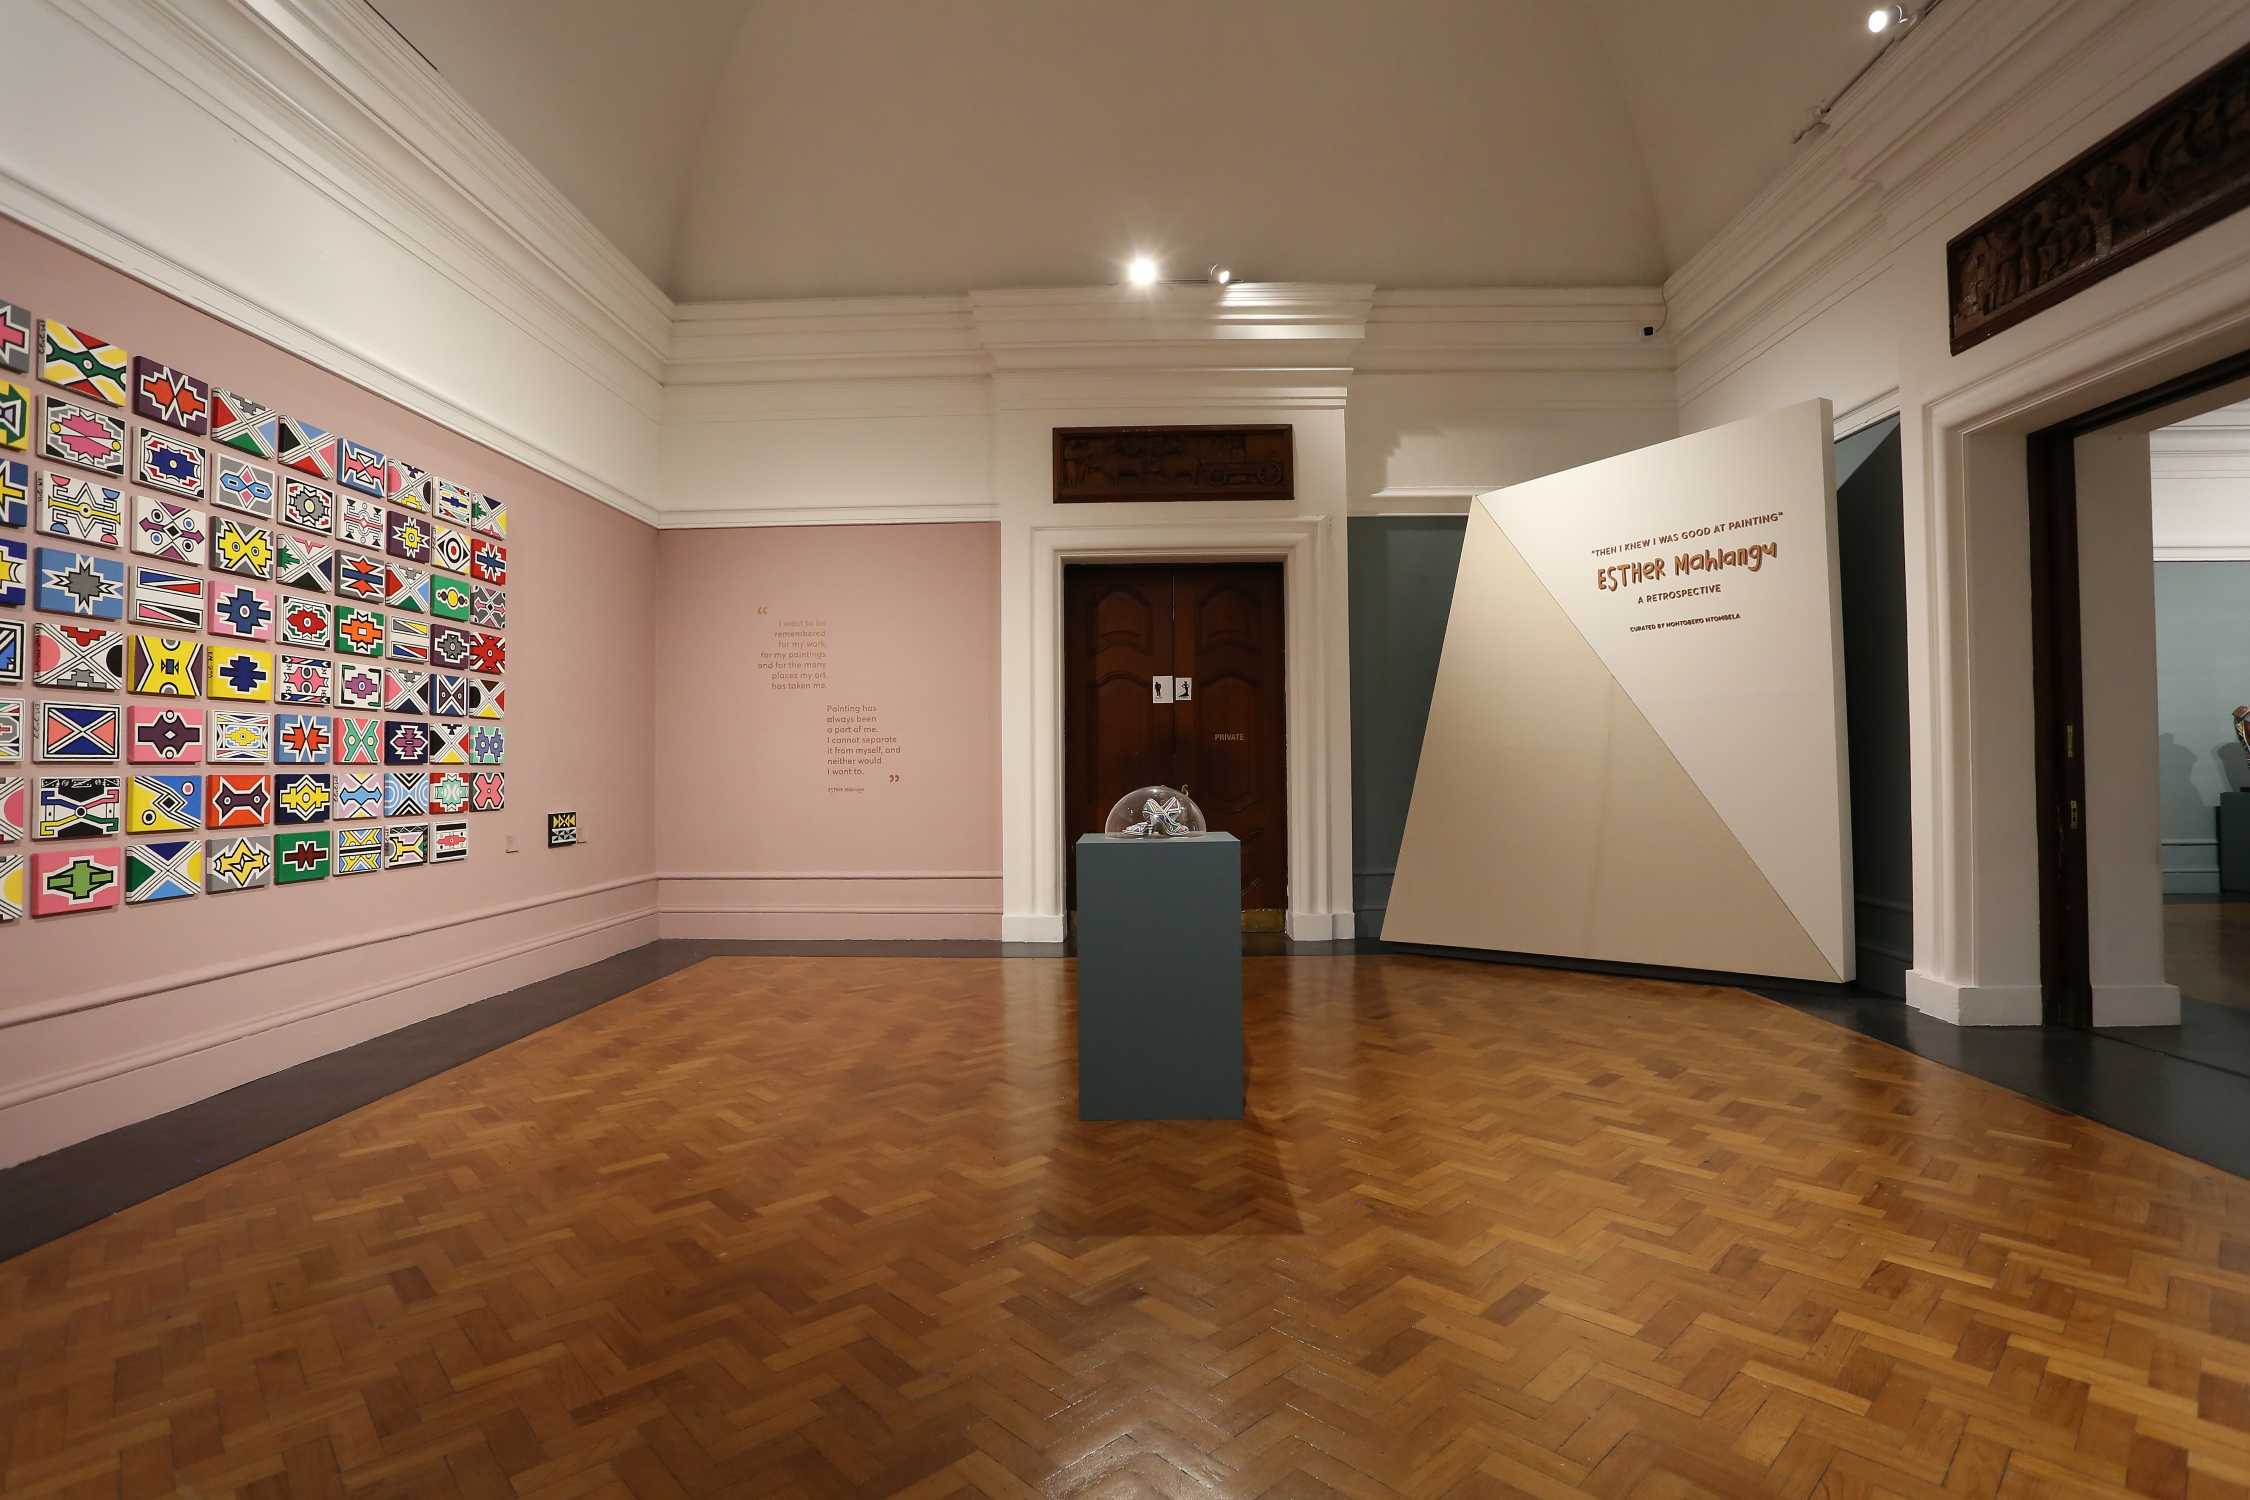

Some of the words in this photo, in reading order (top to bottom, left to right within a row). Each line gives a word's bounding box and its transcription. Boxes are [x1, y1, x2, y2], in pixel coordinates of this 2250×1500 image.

[1624, 539, 1651, 551] KNEW
[1658, 533, 1679, 544] WAS
[1681, 527, 1711, 540] GOOD
[1713, 523, 1726, 534] AT
[1674, 542, 1777, 576] Mahlangu
[1637, 596, 1644, 604] A
[1646, 584, 1721, 603] RETROSPECTIVE
[1630, 624, 1656, 633] CURATED
[774, 652, 786, 660] my
[800, 673, 812, 681] my
[826, 704, 861, 713] Painting
[826, 716, 854, 724] always
[834, 726, 852, 734] part
[862, 737, 897, 745] separate
[1214, 733, 1245, 741] PRIVATE
[834, 746, 854, 754] from
[855, 746, 883, 755] myself,
[885, 746, 901, 754] and
[827, 757, 856, 765] neither
[857, 757, 882, 765] would
